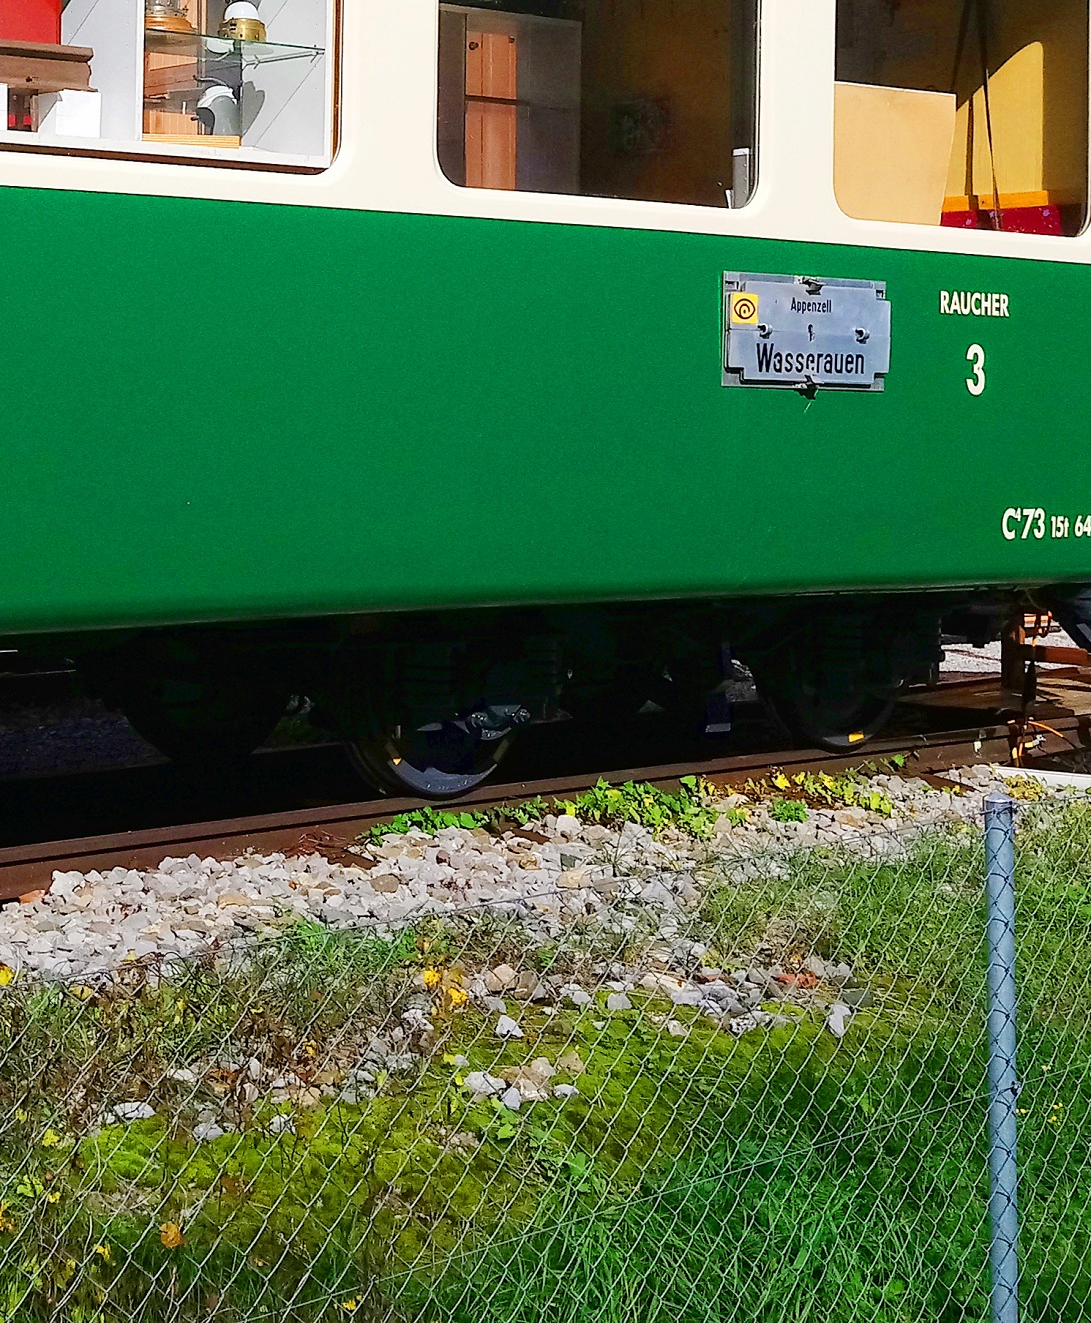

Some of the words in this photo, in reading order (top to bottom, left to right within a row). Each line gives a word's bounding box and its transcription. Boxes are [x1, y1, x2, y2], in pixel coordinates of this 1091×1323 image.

[790, 297, 832, 314] Appenzell
[940, 290, 1010, 317] RAUCHER
[756, 342, 865, 374] Wasserauen
[965, 343, 986, 396] 3
[1050, 515, 1070, 538] 15t
[1074, 515, 1091, 537] 64
